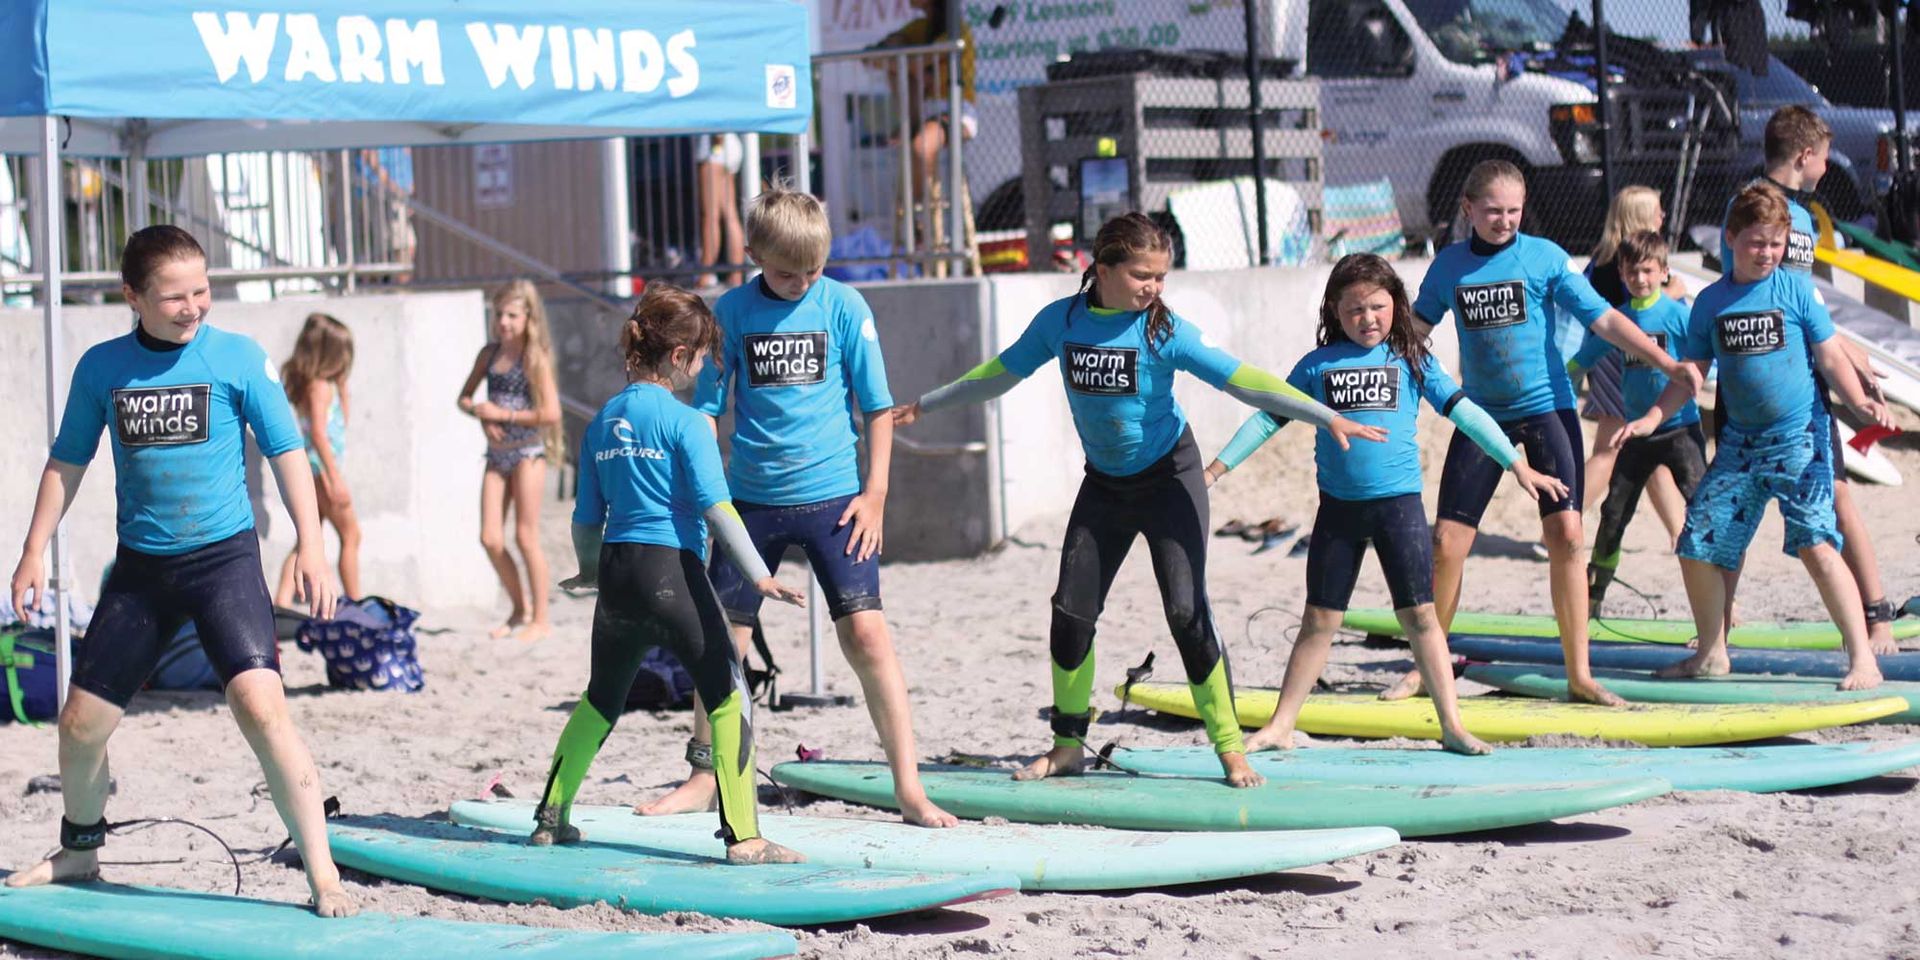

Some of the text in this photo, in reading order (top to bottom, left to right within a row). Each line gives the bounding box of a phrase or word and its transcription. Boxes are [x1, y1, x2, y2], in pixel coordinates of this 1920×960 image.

[191, 11, 700, 98] WARM WINDS
[1789, 232, 1812, 248] warm
[1462, 286, 1514, 304] warm
[1465, 300, 1520, 320] winds
[1724, 316, 1774, 332] warm
[1725, 329, 1780, 346] winds
[753, 339, 814, 356] warm
[755, 353, 819, 376] winds
[1071, 351, 1125, 369] warm
[1072, 367, 1130, 388] winds
[1330, 370, 1388, 386] warm
[1332, 383, 1392, 403] winds
[122, 393, 193, 413] warm
[123, 410, 199, 435] winds
